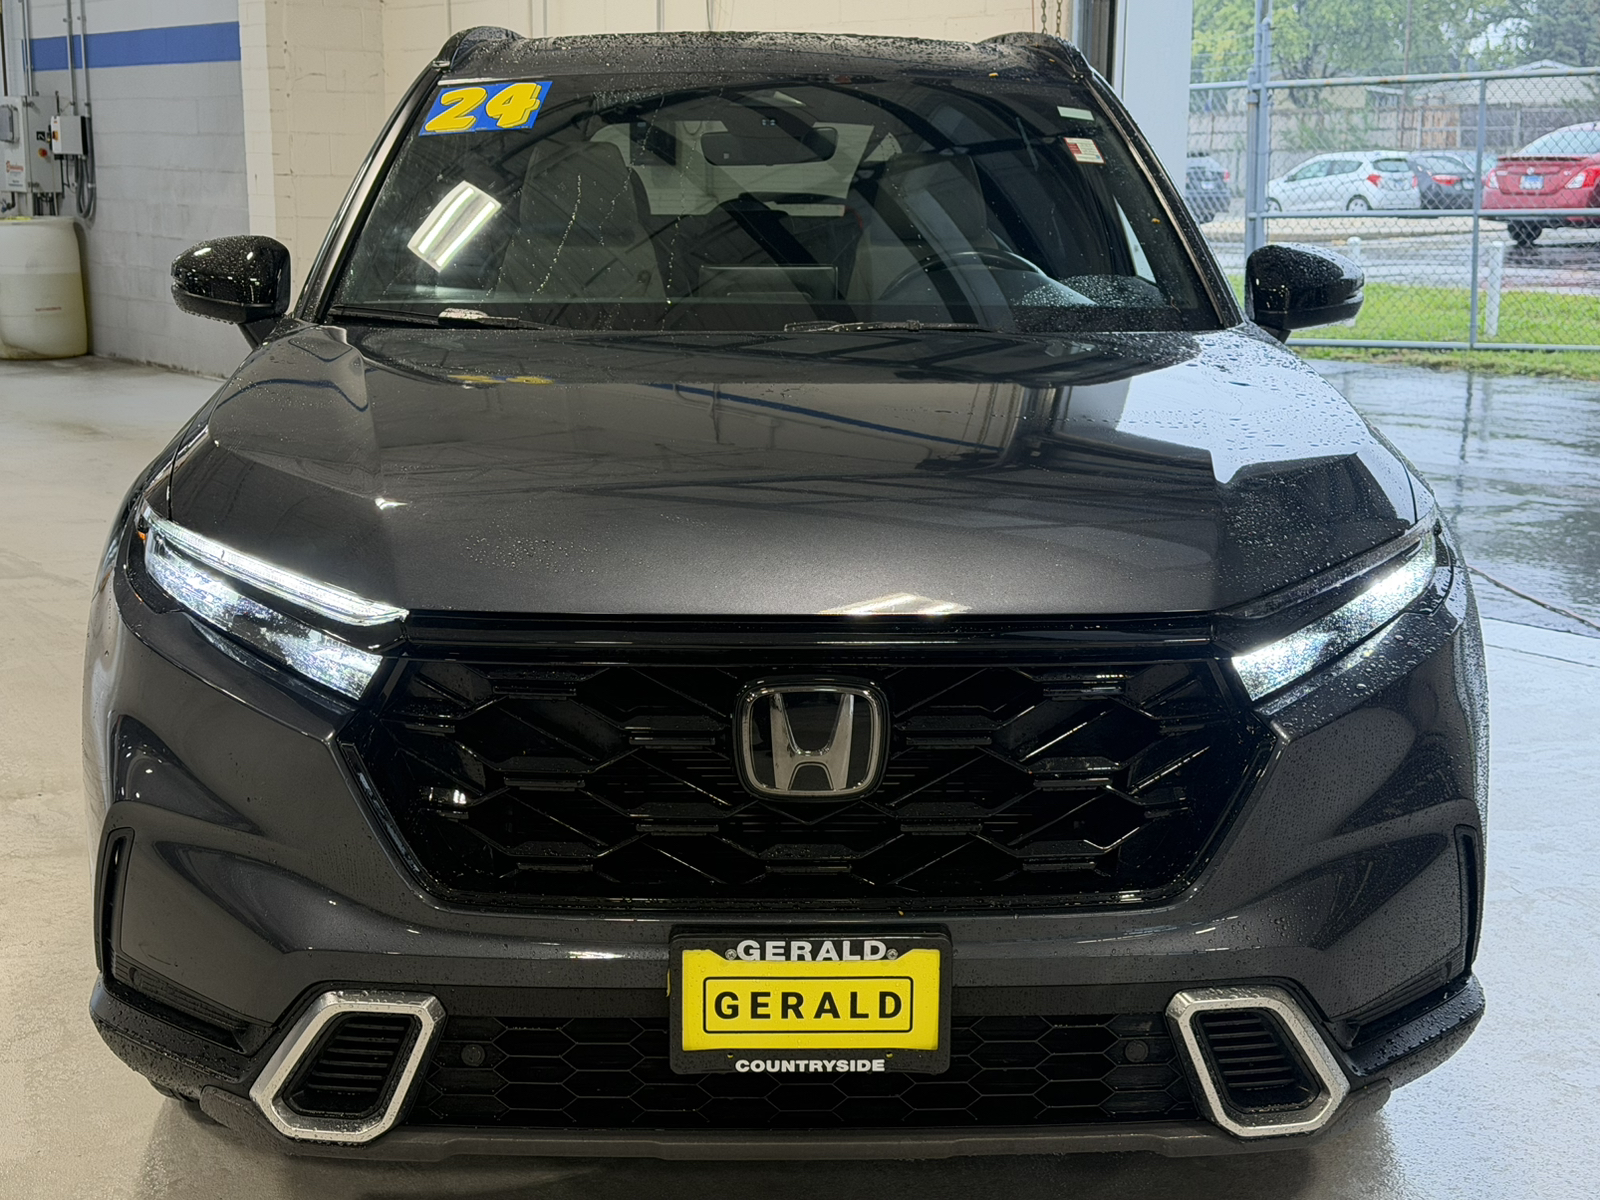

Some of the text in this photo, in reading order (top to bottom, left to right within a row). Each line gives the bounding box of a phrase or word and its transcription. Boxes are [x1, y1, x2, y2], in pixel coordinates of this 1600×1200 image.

[425, 83, 542, 132] 24
[736, 940, 887, 961] GERALD
[714, 991, 902, 1019] GERALD
[735, 1059, 885, 1072] COUNTRYSIDE
